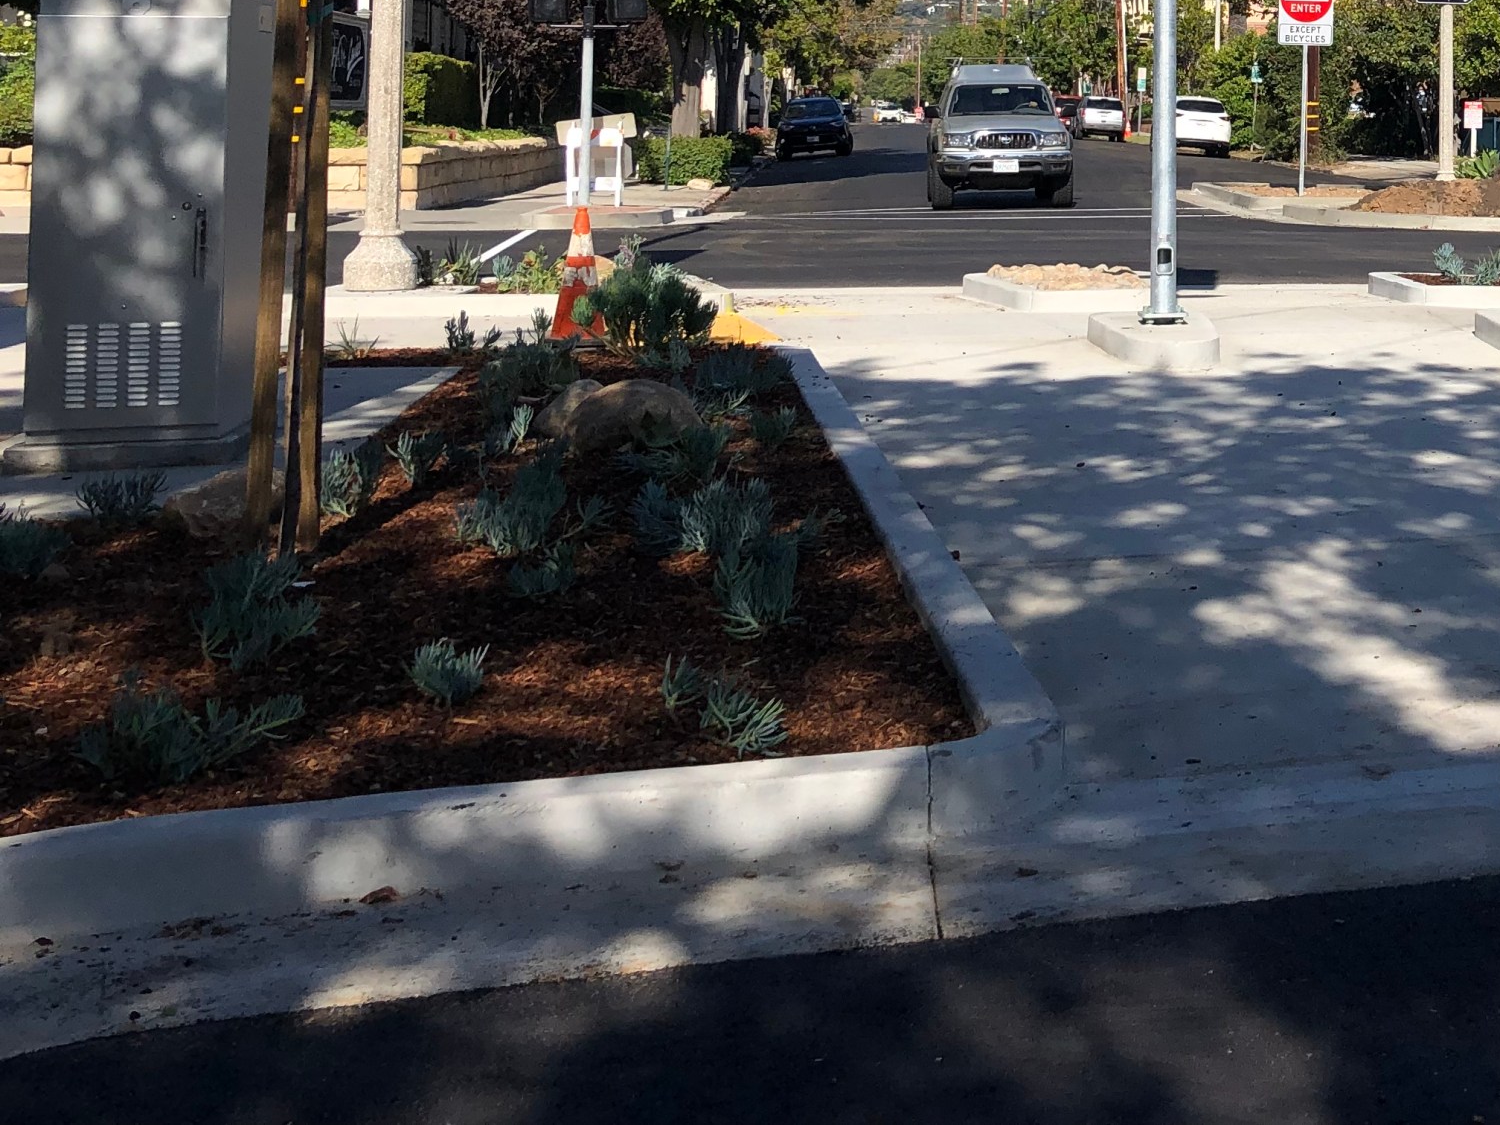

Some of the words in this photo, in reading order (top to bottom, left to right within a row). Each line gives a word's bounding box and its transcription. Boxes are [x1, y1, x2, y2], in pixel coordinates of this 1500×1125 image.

[1290, 3, 1322, 13] ENTER
[1290, 26, 1321, 34] EXCEPT
[1285, 35, 1326, 43] BICYCLES
